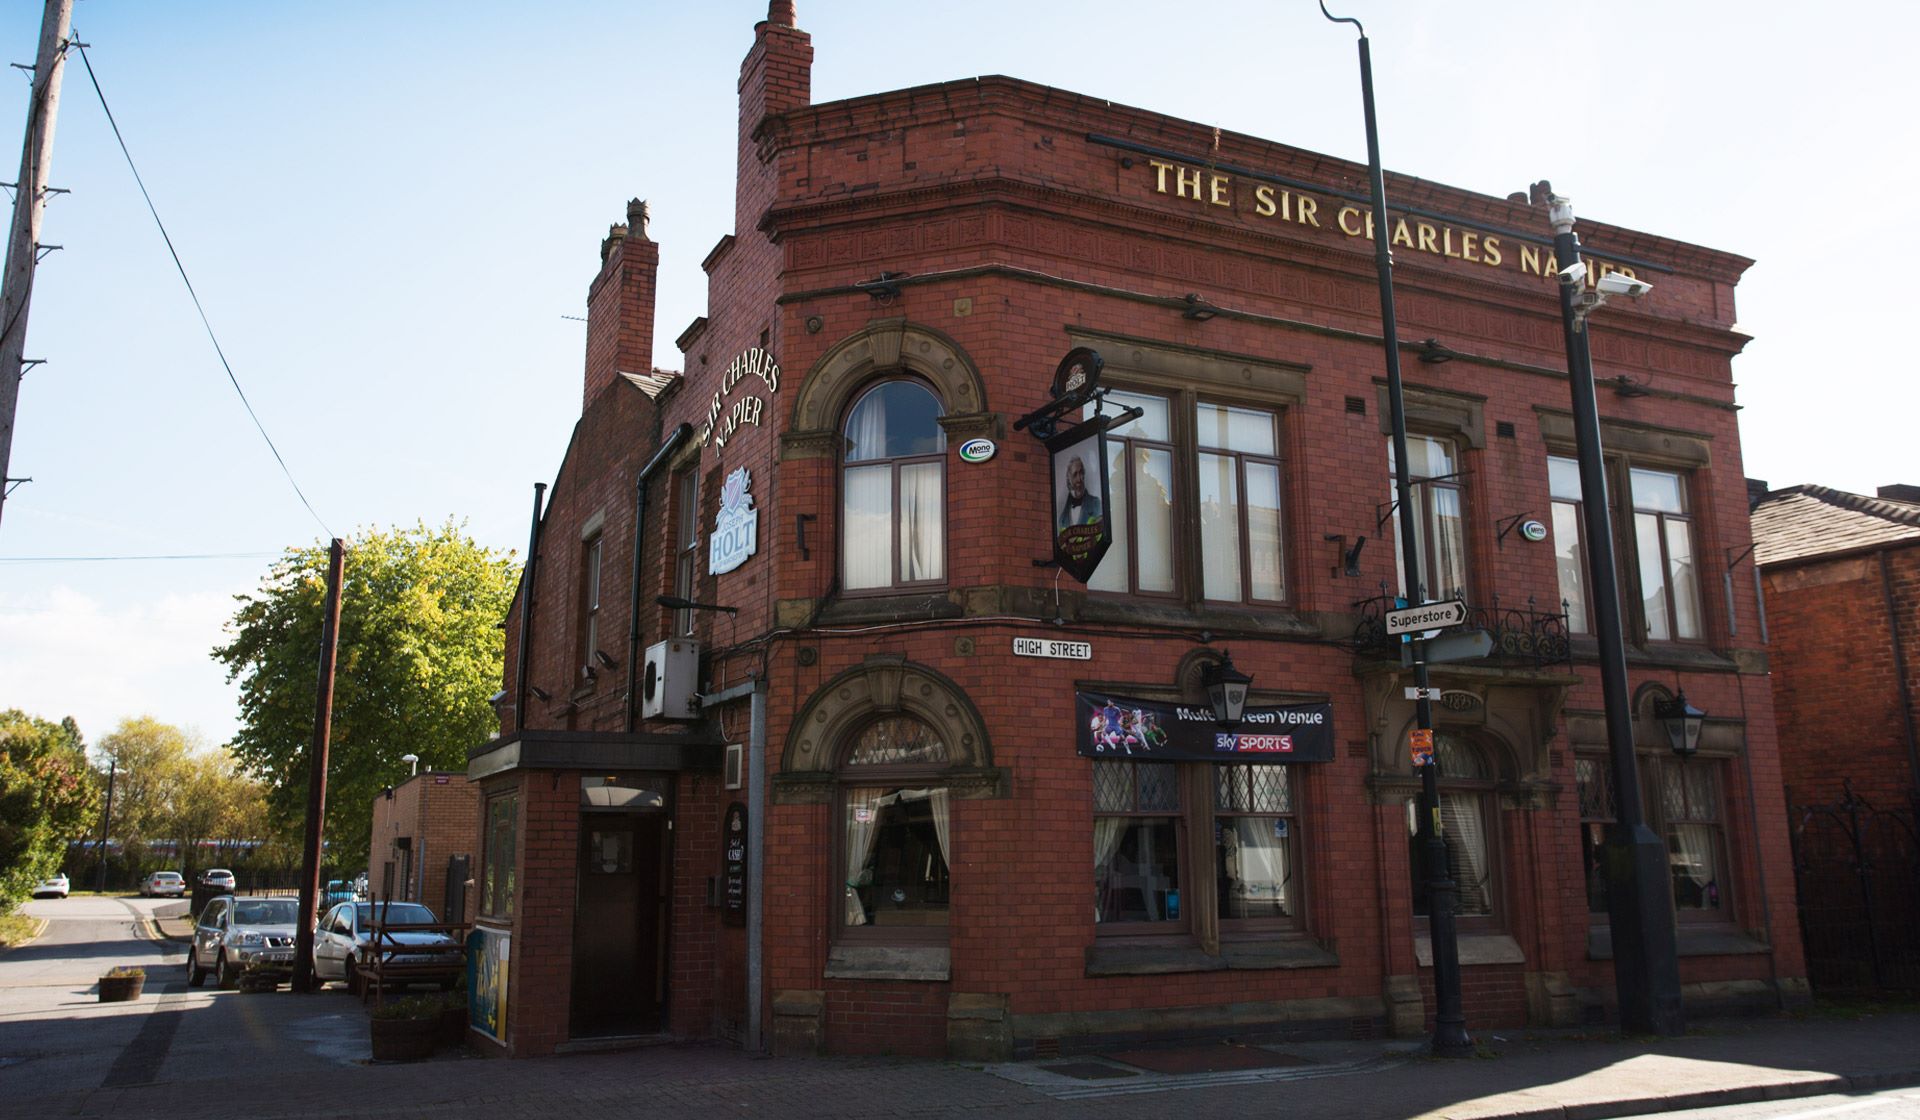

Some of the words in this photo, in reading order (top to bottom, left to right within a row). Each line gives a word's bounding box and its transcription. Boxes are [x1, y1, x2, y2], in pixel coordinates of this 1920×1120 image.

[1150, 159, 1230, 207] THE
[1255, 184, 1321, 228] SIR
[702, 391, 723, 448] SIR
[722, 347, 780, 396] CHARLES
[714, 396, 763, 458] NAPIER
[712, 519, 754, 564] HOLT
[1390, 609, 1452, 628] Superstore
[1016, 640, 1042, 655] HIGH
[1050, 642, 1090, 658] STREET
[1176, 707, 1216, 721] Mult
[1276, 710, 1323, 724] Venue
[1216, 735, 1237, 751] sky
[1240, 737, 1291, 750] SPORTS
